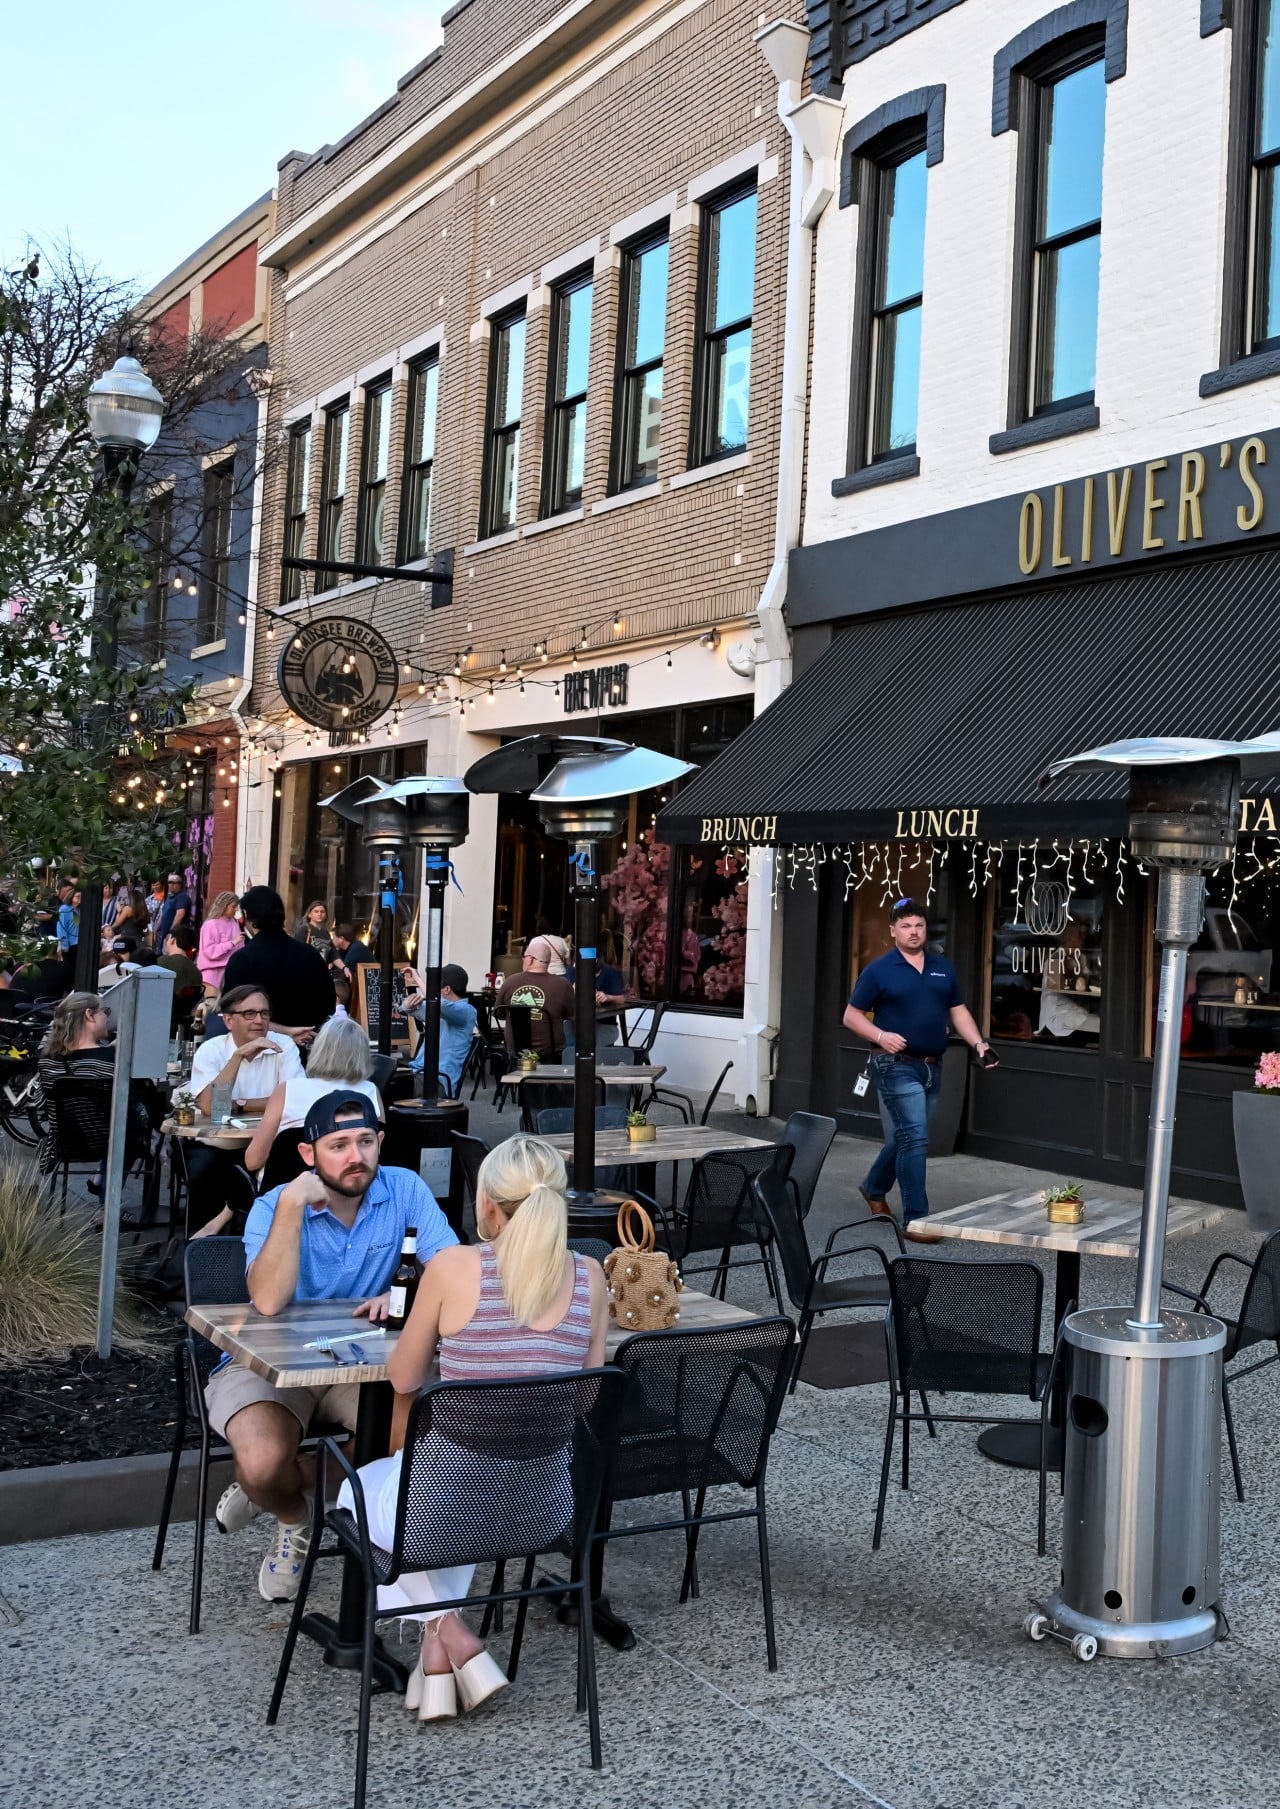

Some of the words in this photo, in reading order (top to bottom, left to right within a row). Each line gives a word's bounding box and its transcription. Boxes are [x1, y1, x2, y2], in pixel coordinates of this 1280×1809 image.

[1018, 437, 1266, 575] OLIVER'S
[700, 815, 778, 842] BRUNCH
[895, 808, 980, 838] LUNCH
[1011, 946, 1081, 976] OLIVER'S
